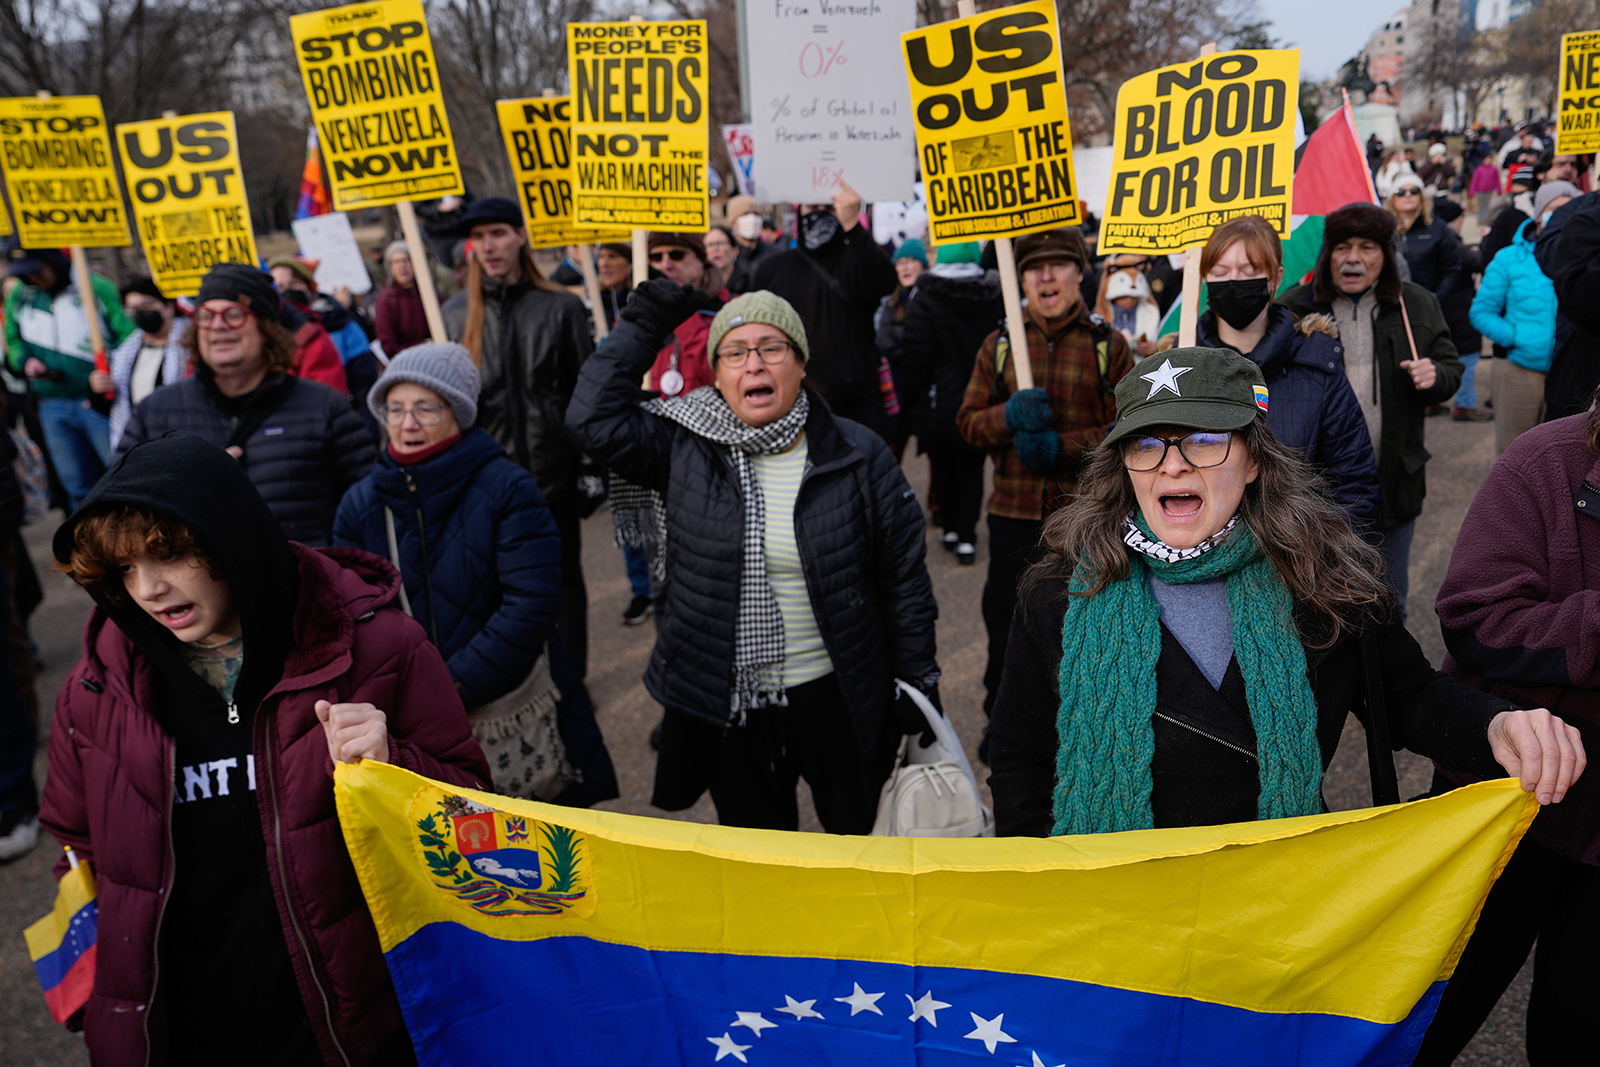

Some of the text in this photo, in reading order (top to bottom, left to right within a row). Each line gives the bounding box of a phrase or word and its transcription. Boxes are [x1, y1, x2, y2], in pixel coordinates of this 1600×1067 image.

[819, 0, 882, 17] Venezuela
[301, 21, 423, 62] STOP
[574, 25, 702, 38] MONEY FOR
[575, 40, 702, 54] PEOPLE'S
[905, 11, 1053, 86] US
[798, 40, 848, 78] 0%
[1156, 54, 1258, 97] NO
[308, 50, 434, 109] BOMBING
[577, 57, 701, 124] NEEDS
[770, 94, 791, 122] %
[799, 97, 819, 118] of
[917, 70, 1057, 130] OUT
[0, 116, 99, 134] STOP
[321, 104, 446, 153] VENEZUELA
[1124, 79, 1286, 160] BLOOD
[1562, 113, 1592, 131] WAR
[4, 138, 107, 170] BOMBING
[124, 121, 230, 169] US
[333, 145, 451, 181] NOW!
[511, 127, 571, 171] BLO
[577, 134, 703, 159] NOT THE
[924, 120, 1067, 176] OF THE
[12, 178, 115, 203] VENEZUELA
[135, 168, 235, 203] OUT
[578, 163, 703, 192] WAR MACHINE
[811, 166, 845, 190] 18%
[930, 158, 1072, 217] CARIBBEAN
[1111, 156, 1199, 217] FOR
[1209, 143, 1286, 203] OIL
[22, 208, 119, 224] NOW!
[523, 179, 572, 218] FOR
[143, 216, 158, 240] OF
[214, 205, 245, 231] THE
[936, 204, 1074, 237] PARTY FOR SOCIALISM & LIBERATION
[1107, 223, 1140, 237] PARTY
[1140, 224, 1159, 237] FOR
[1159, 214, 1207, 236] SOCIALISM
[1208, 212, 1224, 225] &
[151, 235, 251, 274] CARIBBEAN
[174, 757, 238, 803] NT
